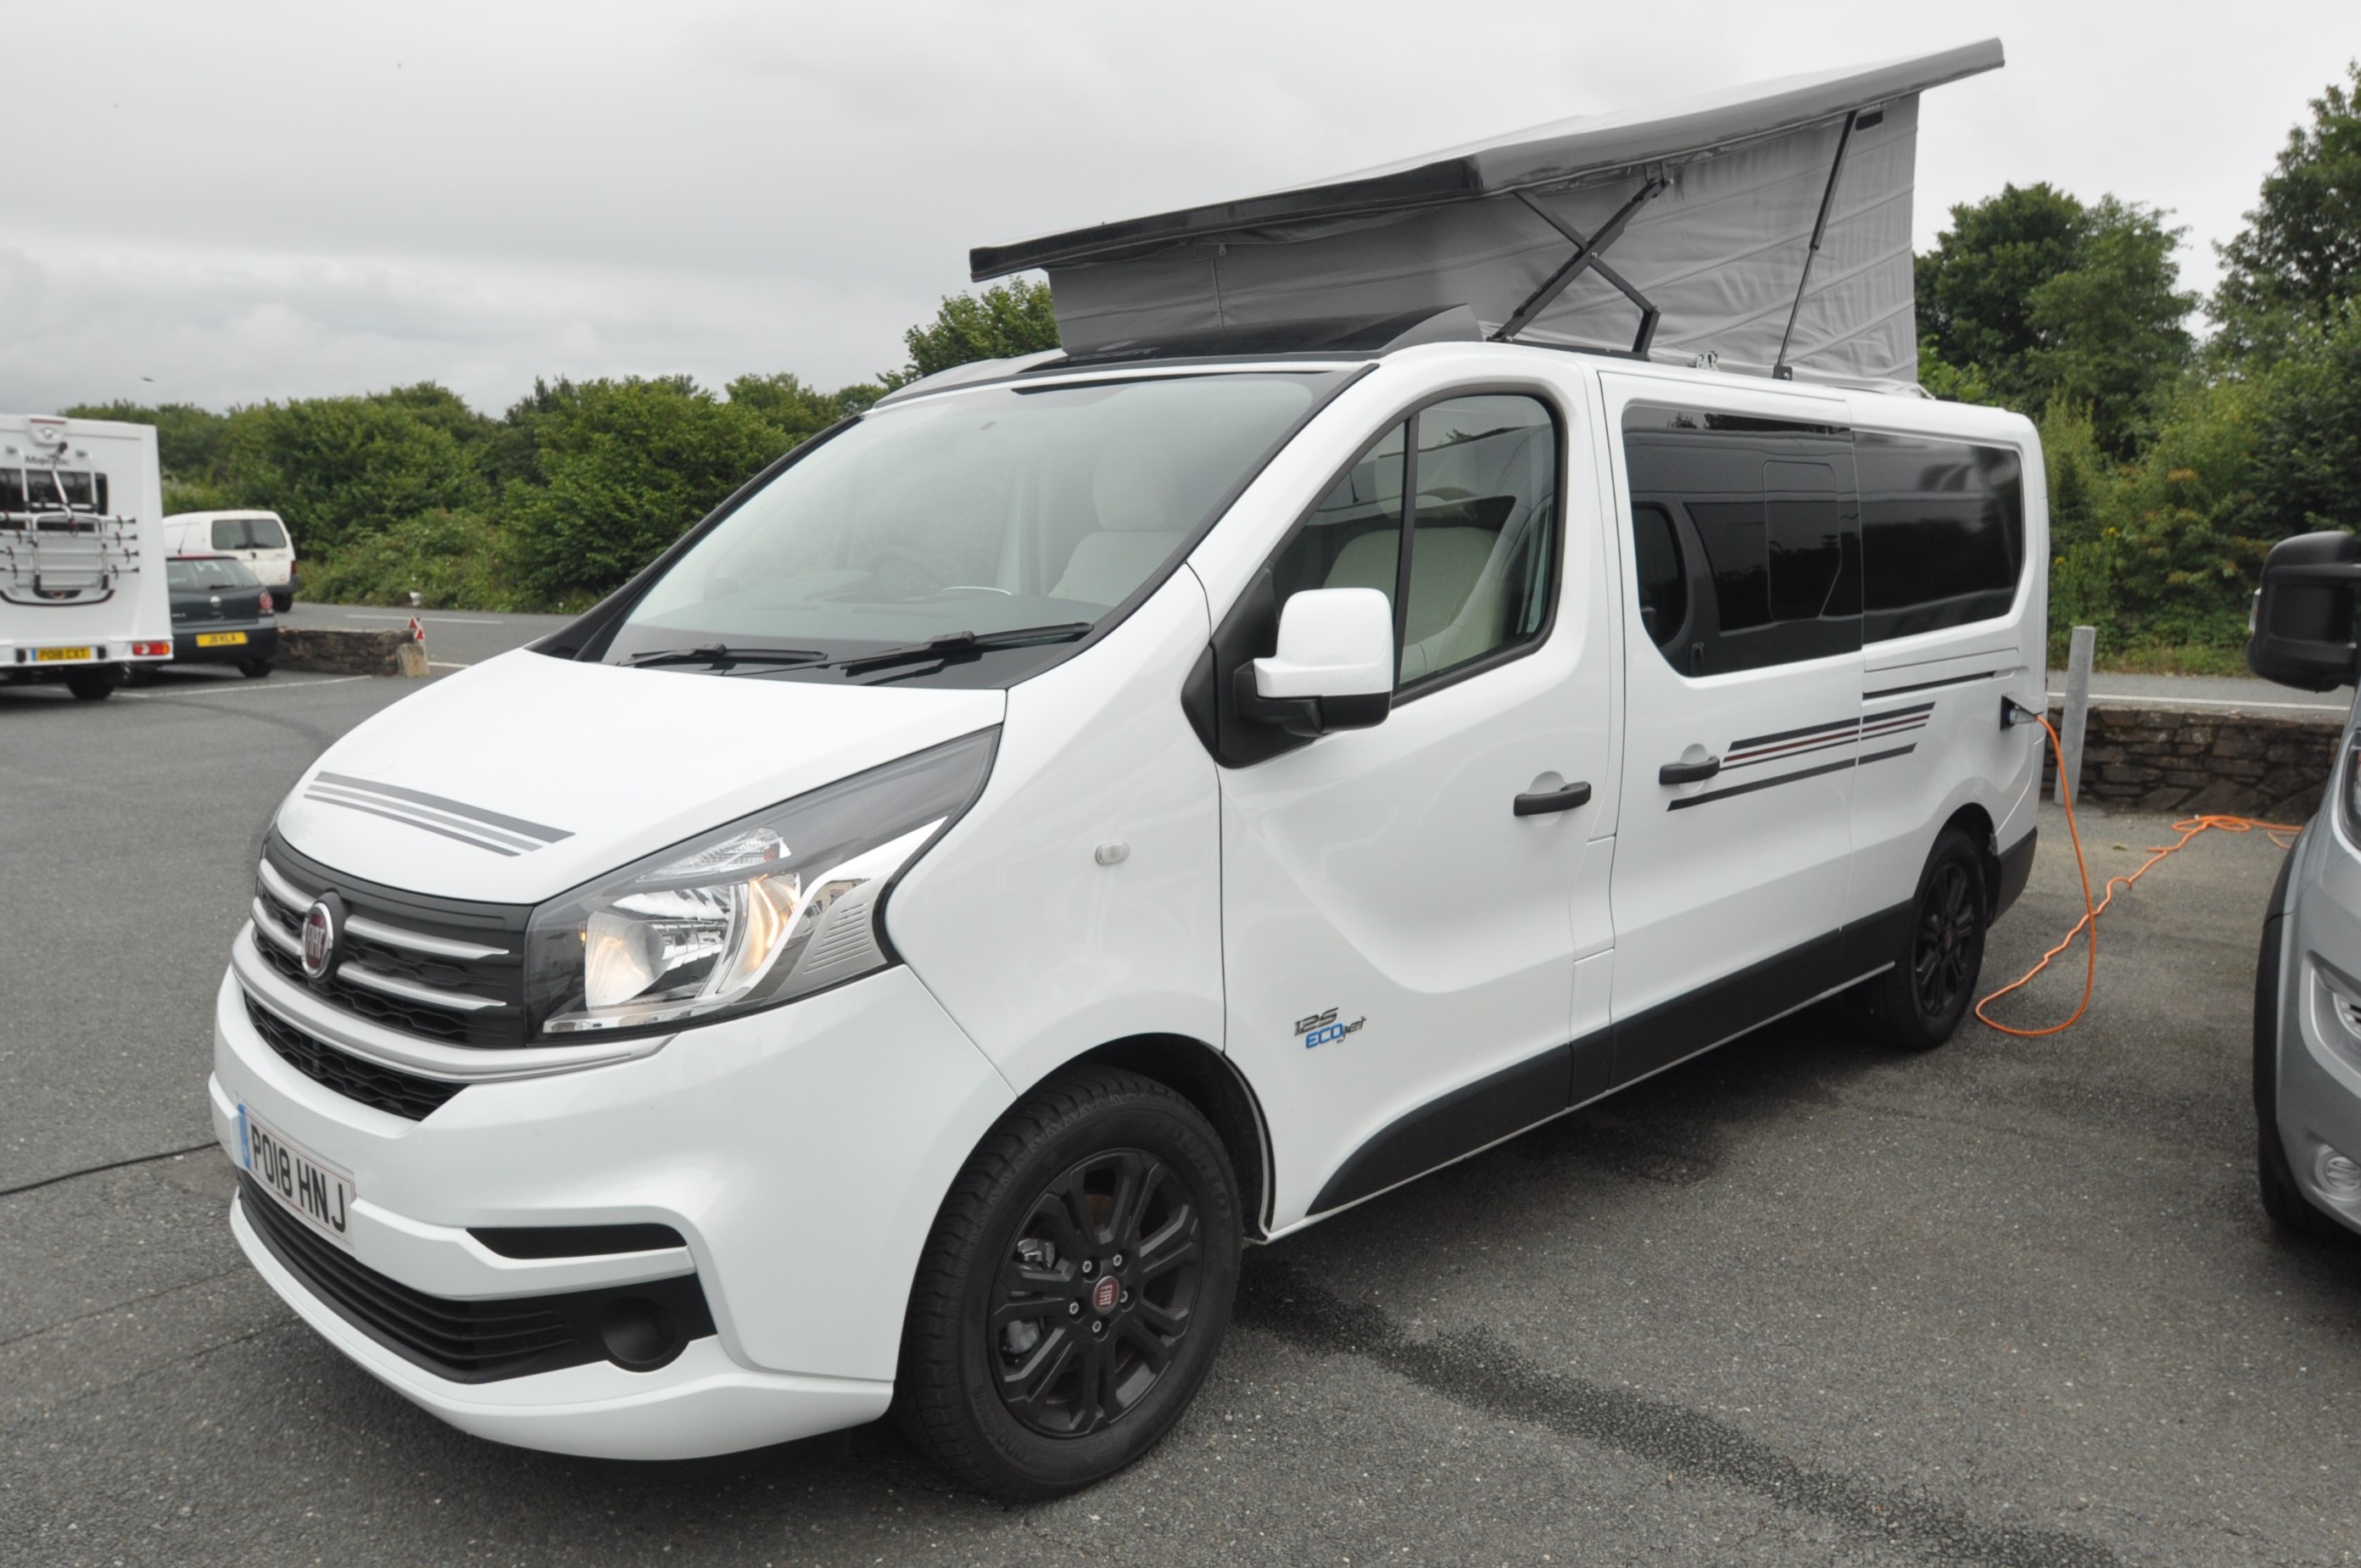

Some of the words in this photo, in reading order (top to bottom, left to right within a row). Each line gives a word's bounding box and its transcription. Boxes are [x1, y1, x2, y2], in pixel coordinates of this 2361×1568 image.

[25, 455, 70, 466] Majetic
[1294, 1007, 1339, 1036] 125
[251, 1123, 293, 1198] PO18
[297, 1158, 346, 1233] HNJ
[1099, 1284, 1113, 1306] FIAT
